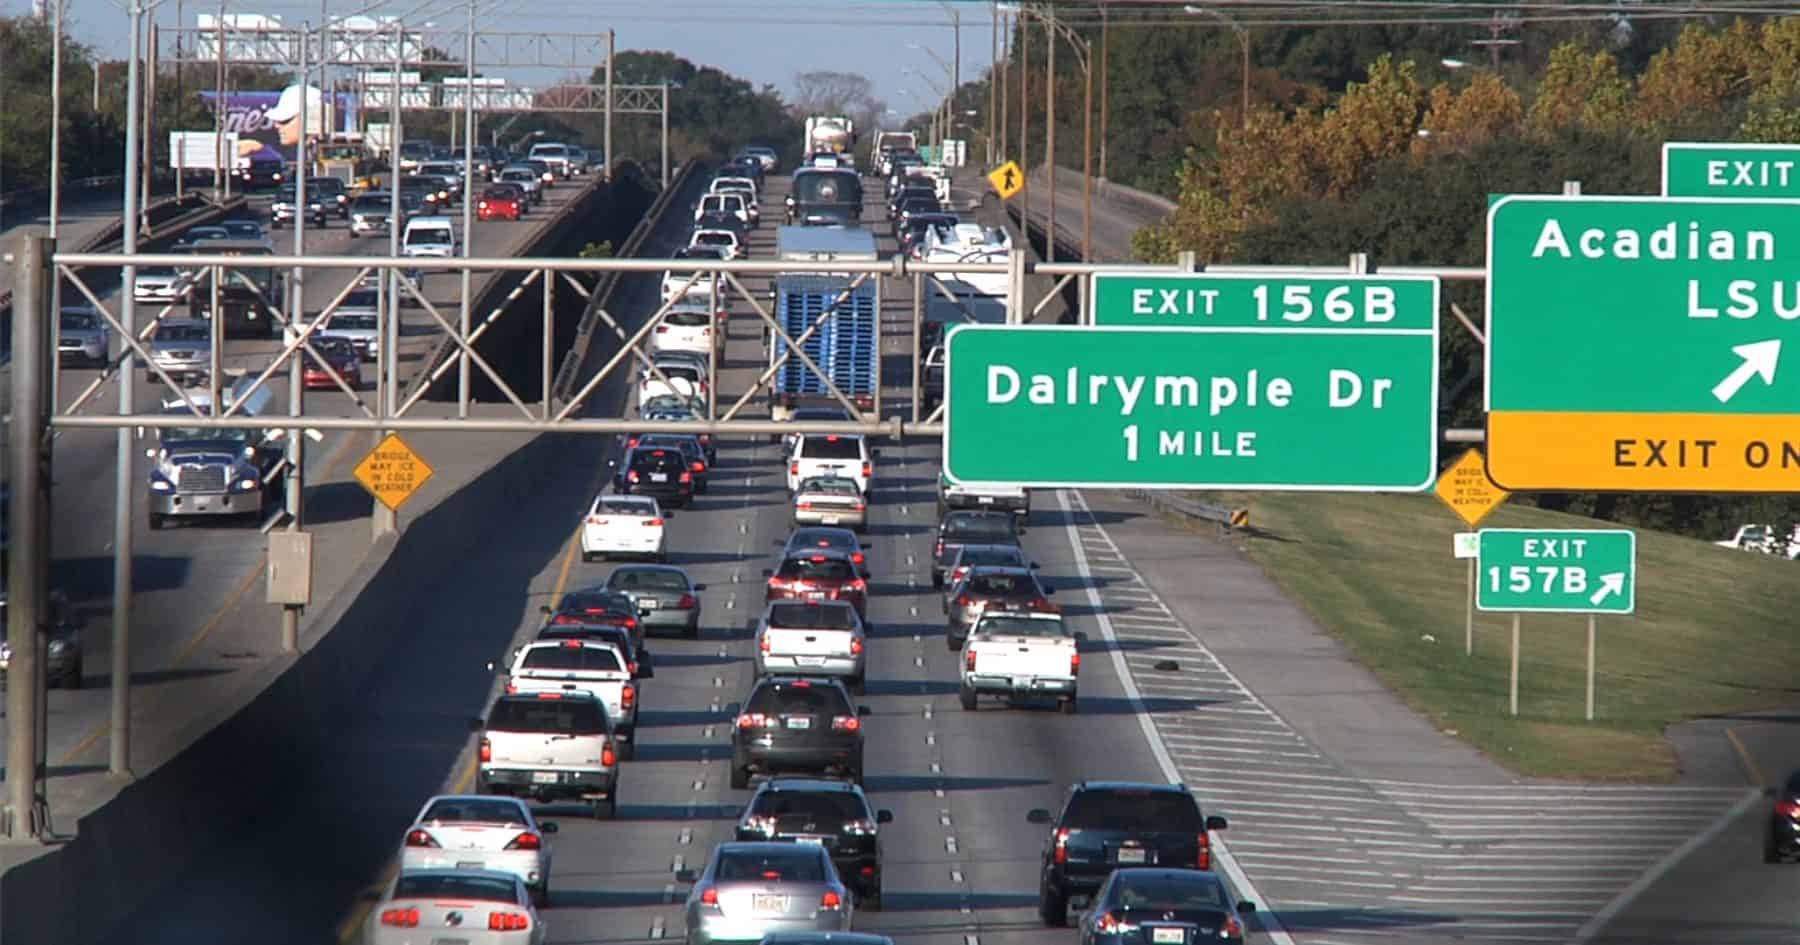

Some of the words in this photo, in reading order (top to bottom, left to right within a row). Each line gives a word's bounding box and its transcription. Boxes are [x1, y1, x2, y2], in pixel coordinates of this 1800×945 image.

[1707, 160, 1794, 187] EXIT
[1532, 219, 1774, 261] Acadian
[1132, 289, 1220, 315] EXIT
[1253, 285, 1397, 323] 156B
[1687, 279, 1800, 320] LSU
[987, 365, 1294, 417] Dalrymple
[1328, 369, 1393, 409] Dr
[1123, 425, 1139, 461] 1
[1158, 431, 1257, 458] MILE
[1614, 439, 1717, 468] EXIT
[1744, 440, 1800, 469] ON
[387, 473, 414, 481] COLD
[1456, 468, 1483, 476] BRIDG
[373, 483, 412, 492] WEATHER
[1523, 539, 1587, 559] EXIT
[1489, 565, 1587, 595] 157B
